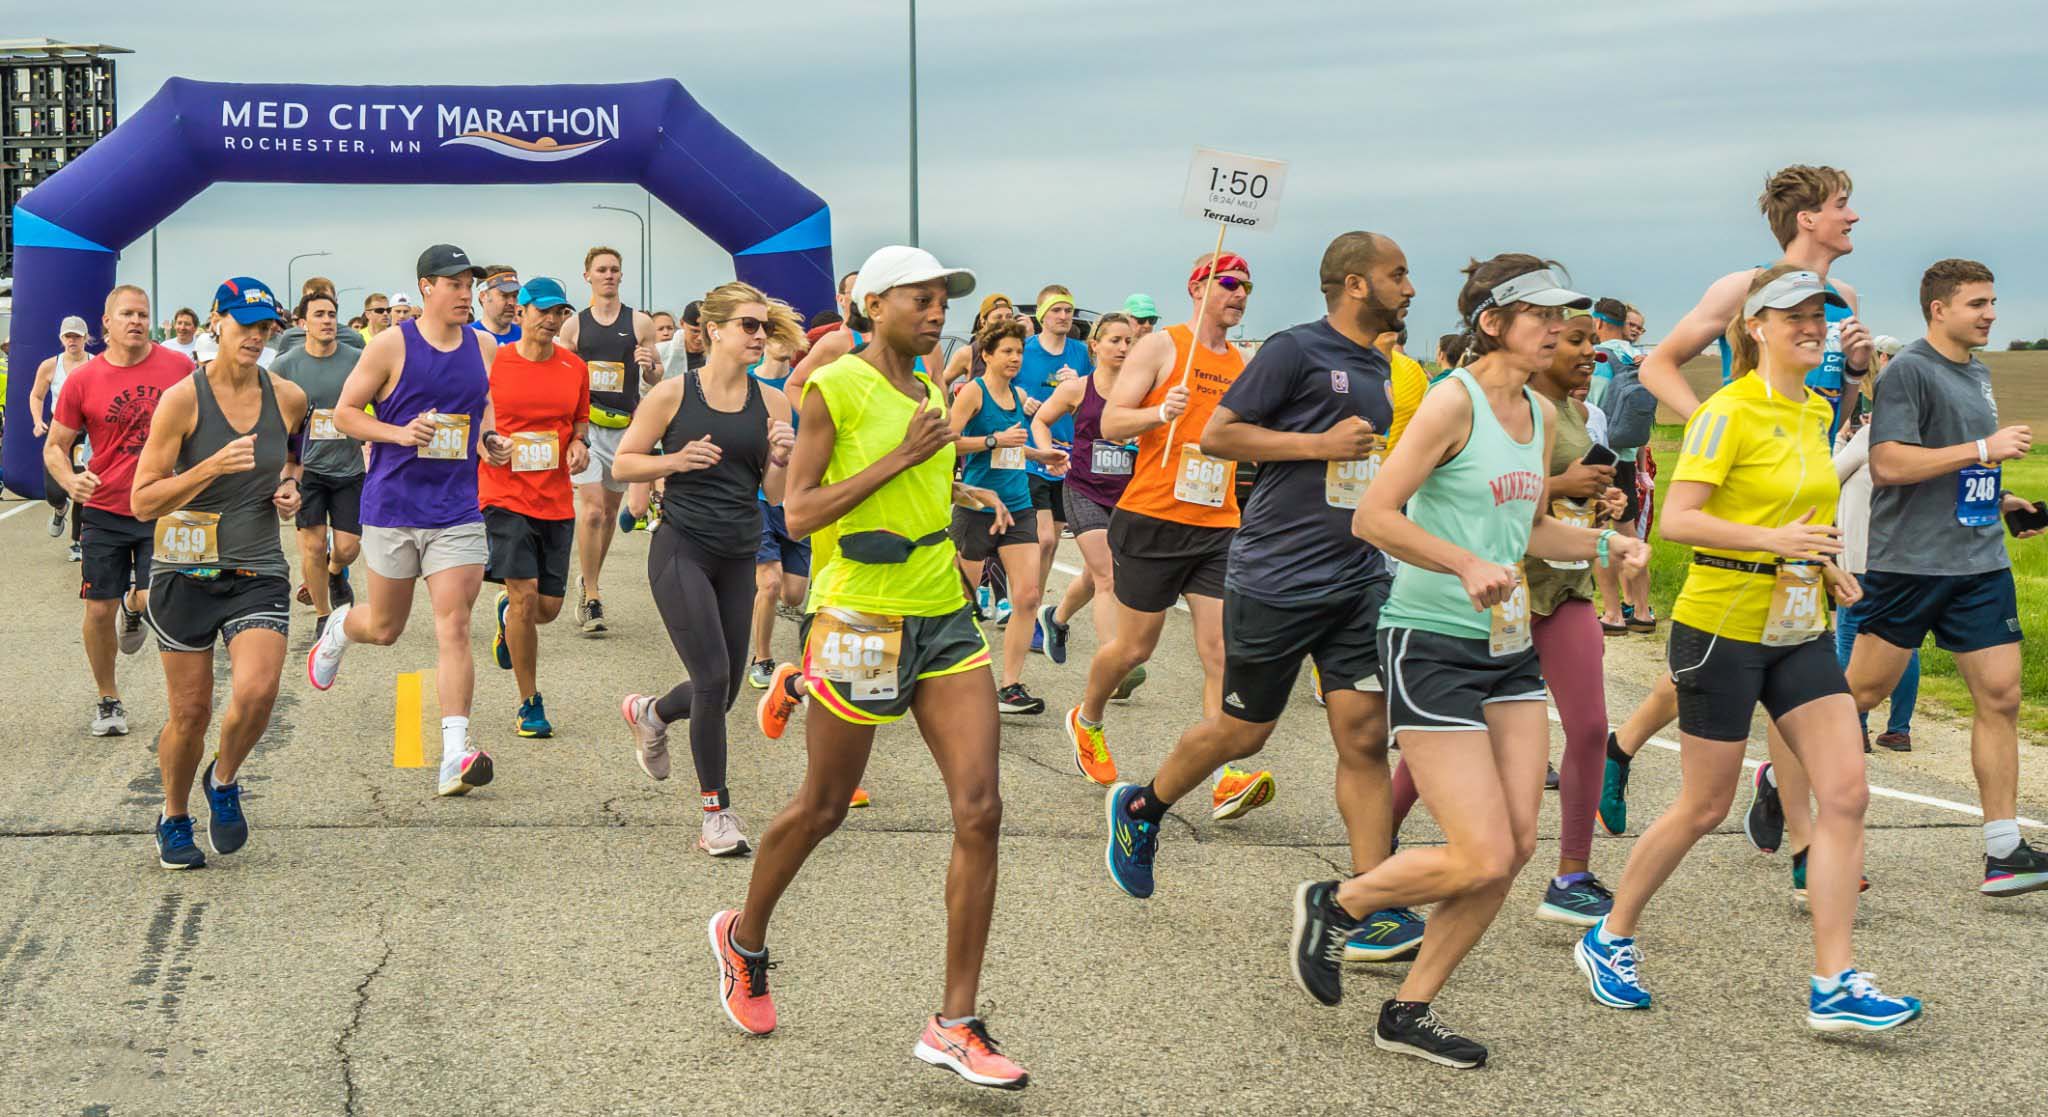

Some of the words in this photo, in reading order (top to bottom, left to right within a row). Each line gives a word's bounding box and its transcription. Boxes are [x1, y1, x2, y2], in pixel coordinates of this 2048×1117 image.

[222, 101, 309, 129] MED
[328, 103, 424, 131] CITY
[437, 103, 620, 140] MARATHON
[224, 136, 375, 154] ROCHESTER,
[390, 140, 421, 153] MN
[1210, 166, 1268, 199] 1:50
[104, 389, 132, 424] SURF
[314, 418, 334, 434] 54
[517, 443, 553, 464] 399
[1094, 450, 1131, 469] 1606
[1186, 458, 1225, 485] 568
[1964, 475, 1996, 503] 248
[162, 526, 206, 554] 439
[1782, 586, 1818, 617] 754
[821, 630, 886, 668] 438
